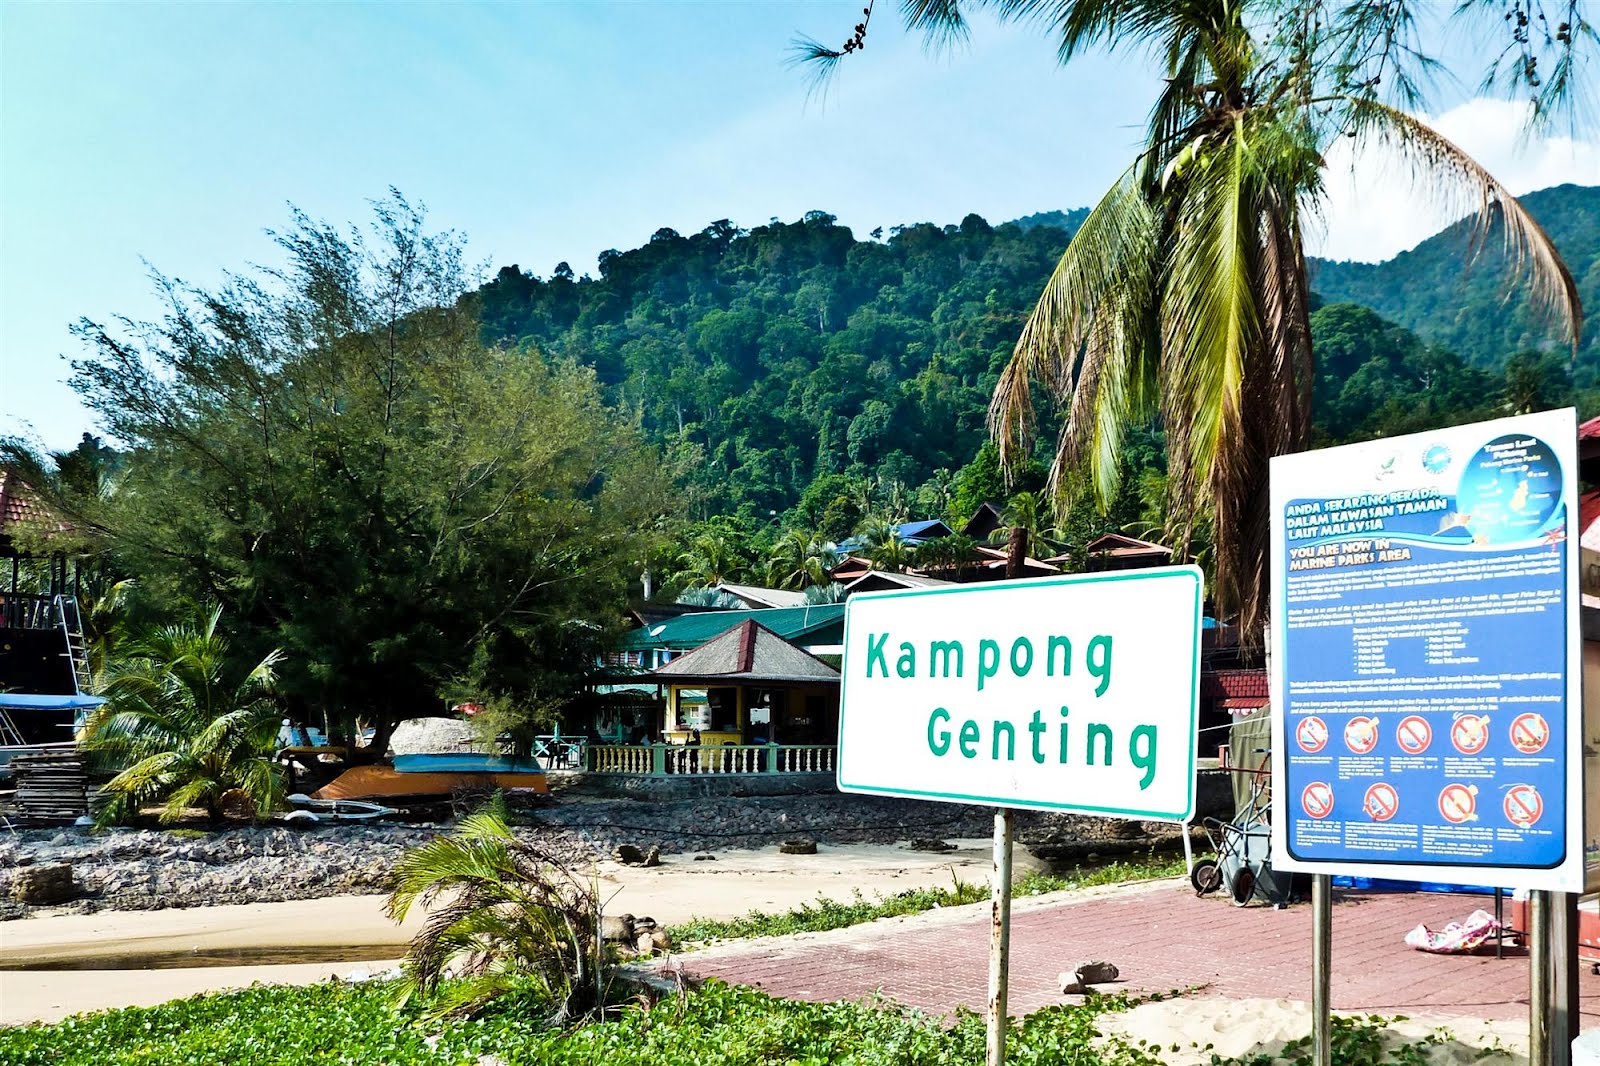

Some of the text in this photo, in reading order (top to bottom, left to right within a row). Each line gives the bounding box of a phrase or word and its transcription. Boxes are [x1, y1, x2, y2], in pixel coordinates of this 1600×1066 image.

[1287, 487, 1440, 517] ANDA SEKARANG BERADA
[1287, 498, 1448, 529] DALAM KAWASAN TAMAN
[1288, 519, 1384, 540] LAUT MALAYSIA
[1289, 538, 1391, 559] YOU ARE NOW IN
[1289, 548, 1412, 571] MARINE PARKS AREA
[866, 632, 1112, 698] Kampong
[927, 705, 1158, 791] Genting
